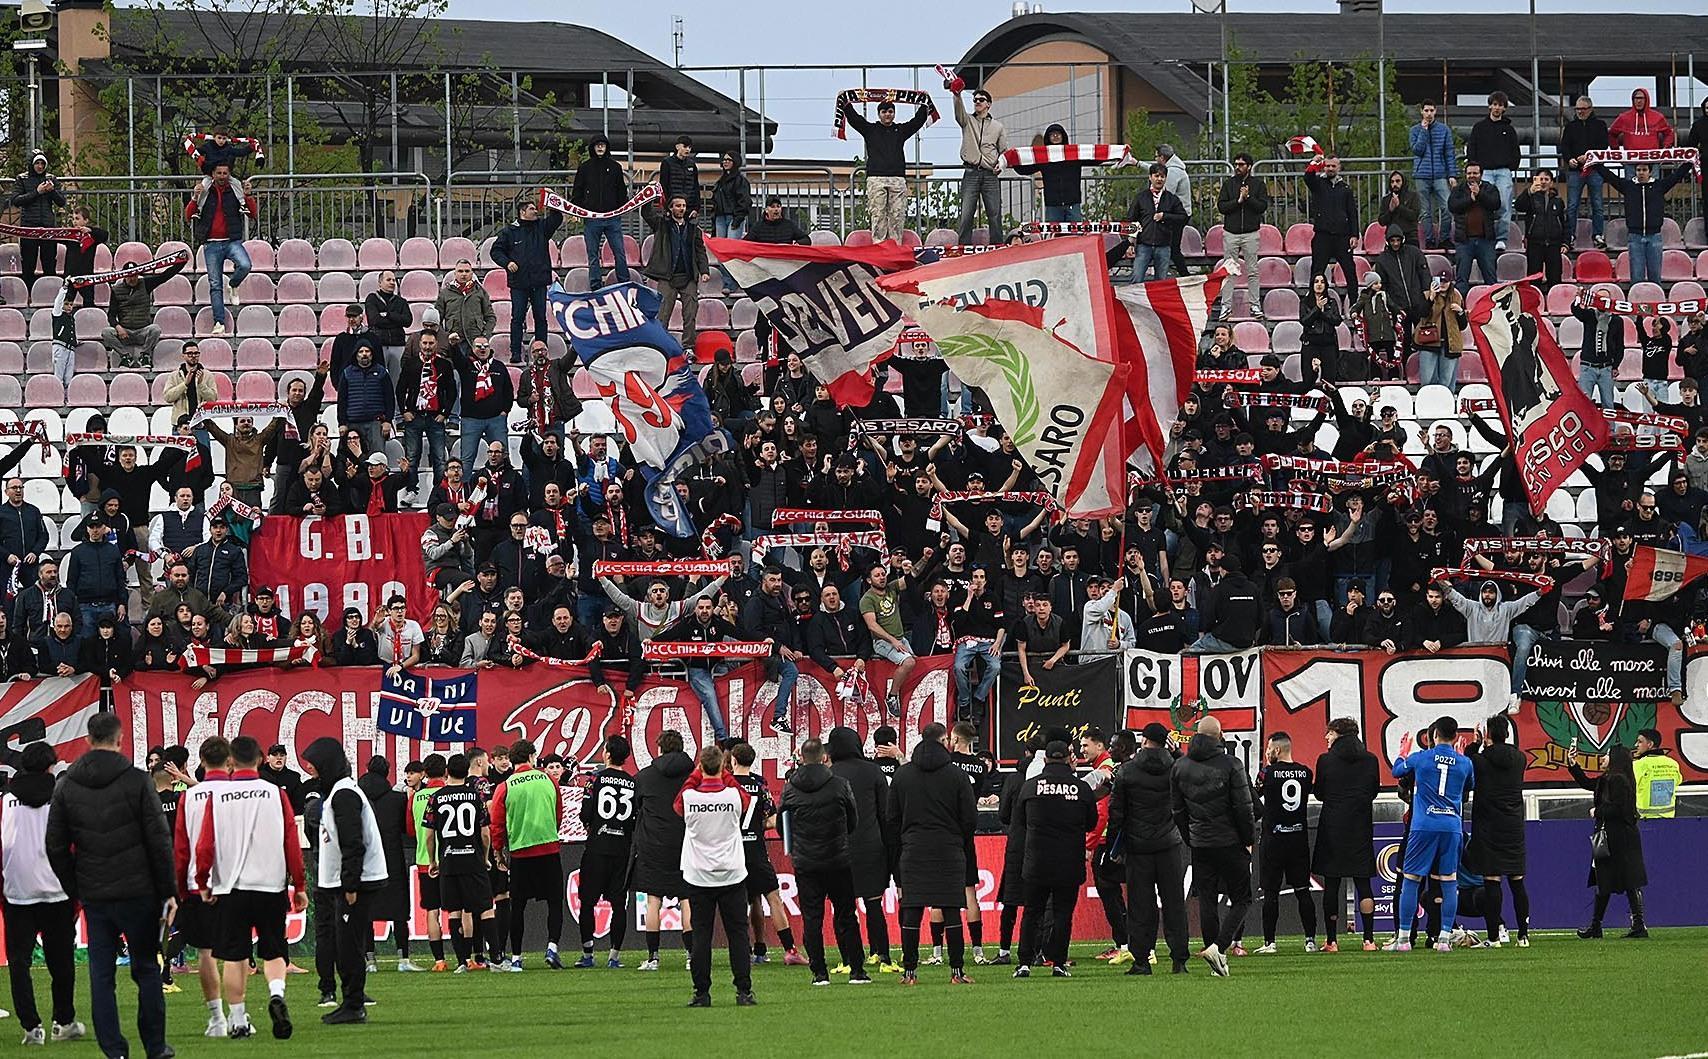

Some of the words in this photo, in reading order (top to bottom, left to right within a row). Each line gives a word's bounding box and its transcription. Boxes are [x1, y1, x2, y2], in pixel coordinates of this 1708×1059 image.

[1592, 151, 1624, 161] VIS
[1626, 148, 1697, 161] PESARO
[1227, 370, 1261, 381] SOLA
[882, 420, 960, 433] PESARO
[1465, 540, 1503, 552] VIS
[1511, 540, 1602, 552] PESARO
[1569, 648, 1602, 672] alle
[1585, 676, 1622, 699] alle
[1017, 684, 1083, 710] Punti
[1434, 754, 1456, 766] POZZI
[510, 773, 548, 787] macron
[1273, 770, 1307, 779] NICASTRO
[1436, 763, 1449, 797] 1
[600, 776, 635, 789] BARRANCO
[220, 789, 271, 803] macron
[1036, 784, 1079, 796] PESARO
[1281, 779, 1302, 812] 9
[436, 792, 477, 804] GIOVANNINI
[597, 786, 635, 822] 63
[688, 802, 734, 813] macron
[437, 802, 477, 838] 20
[1374, 903, 1390, 914] sky
